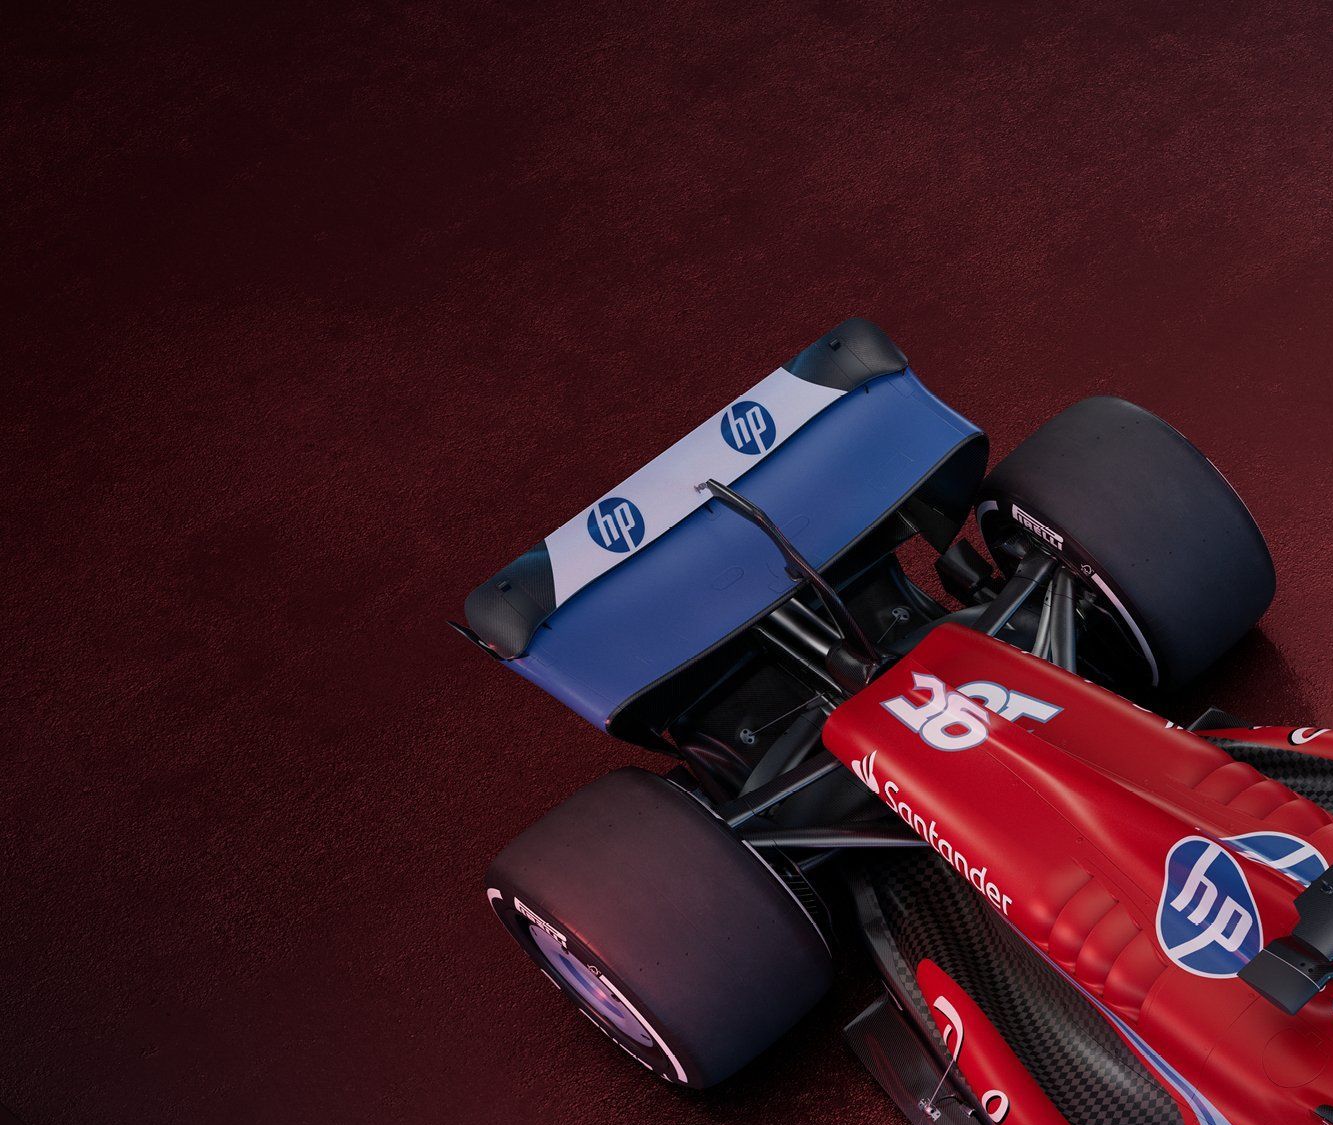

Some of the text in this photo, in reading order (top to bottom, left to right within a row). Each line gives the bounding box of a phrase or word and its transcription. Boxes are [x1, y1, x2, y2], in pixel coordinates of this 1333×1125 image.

[723, 400, 774, 454] hp
[590, 498, 643, 552] hp
[1012, 504, 1064, 551] PIRELLI
[885, 780, 1013, 916] Santander
[1160, 840, 1258, 968] hp
